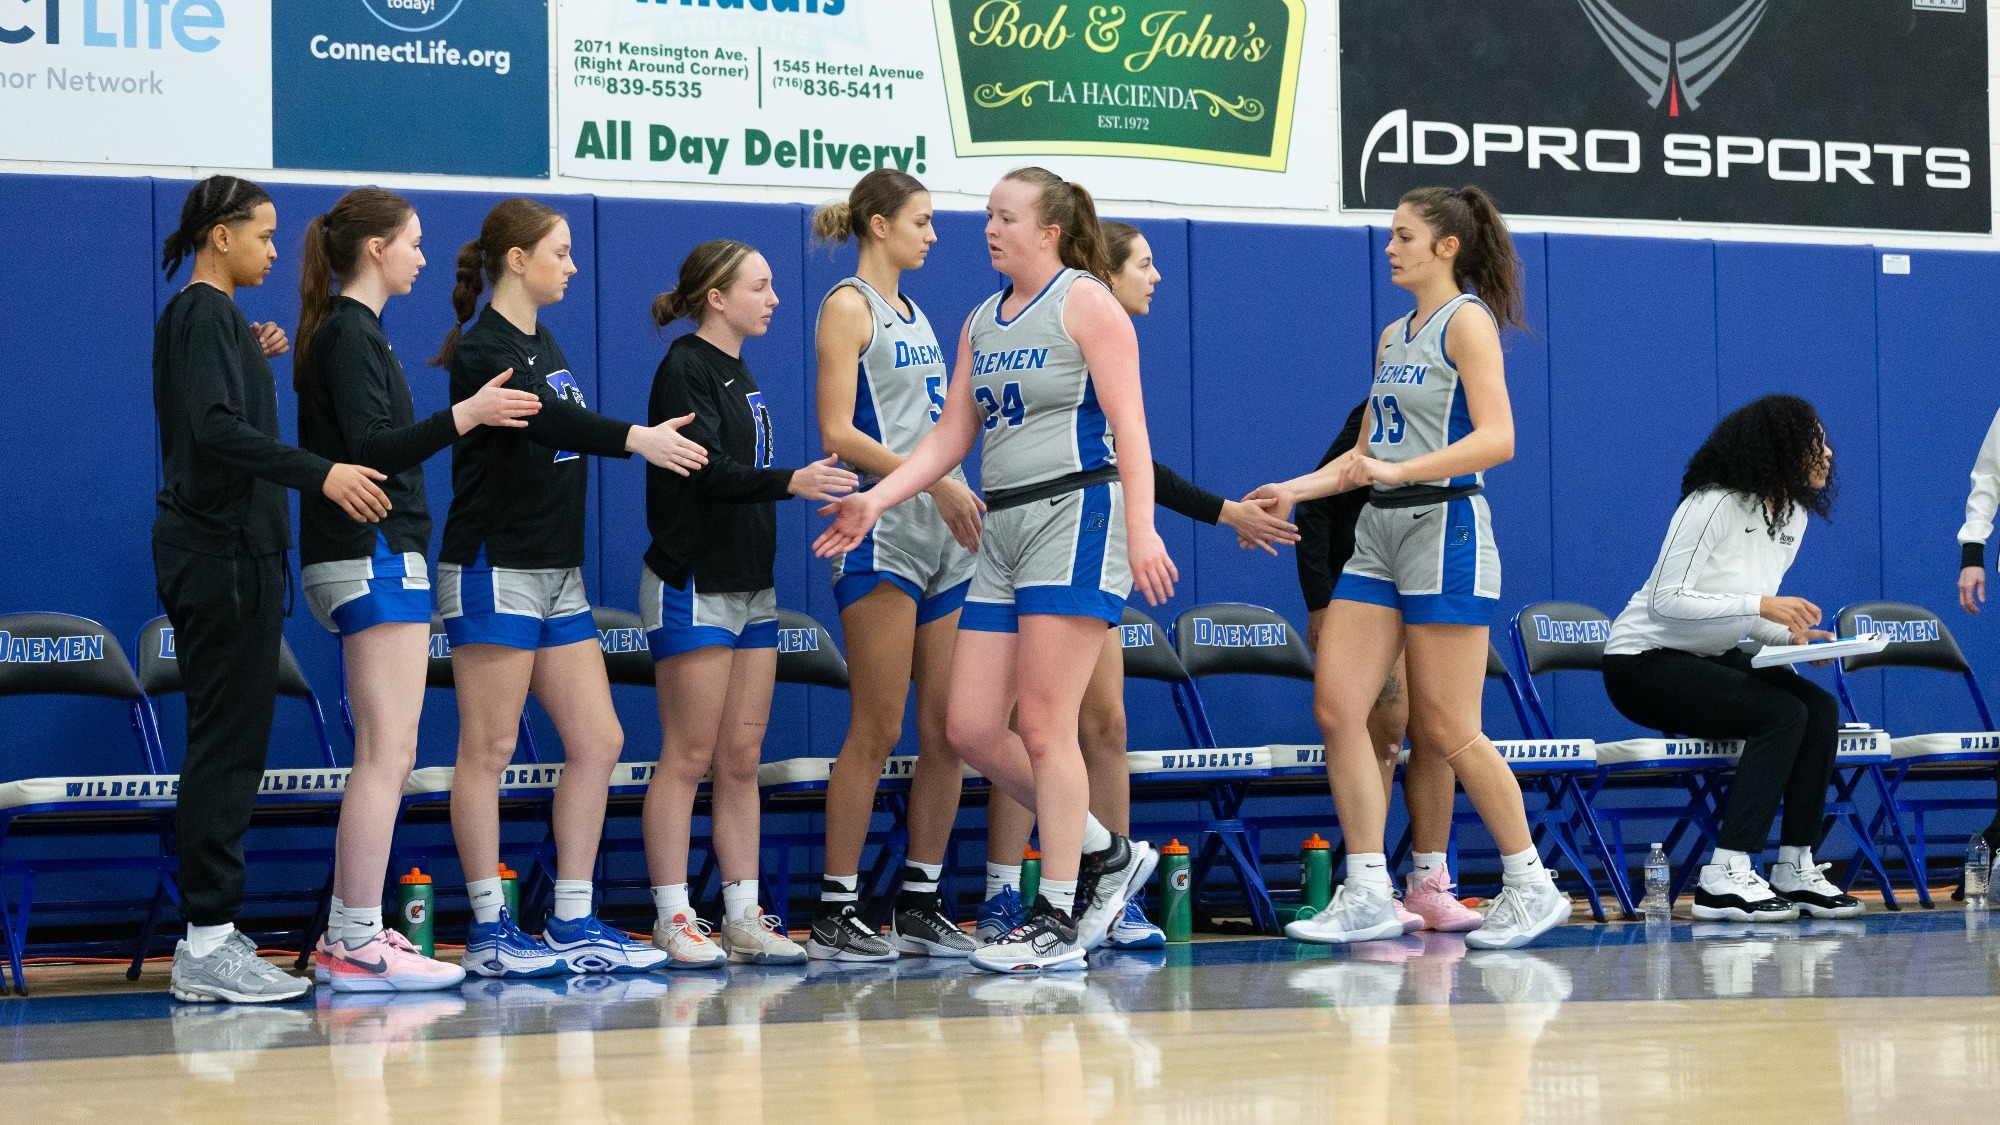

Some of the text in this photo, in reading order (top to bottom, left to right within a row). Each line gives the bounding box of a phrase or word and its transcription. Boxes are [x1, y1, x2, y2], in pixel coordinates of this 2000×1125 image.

[574, 39, 748, 61] 2071 Kensington Ave.
[968, 0, 1272, 73] Bob & John's
[310, 35, 511, 75] ConnectLife.org
[574, 57, 749, 79] (Right Around Corner)
[47, 67, 164, 95] Network
[773, 60, 925, 80] 1545 Hertel Avenue
[1047, 80, 1199, 110] LA HACIENDA
[574, 119, 926, 175] All Day Delivery!
[1360, 109, 1971, 203] ADPRO SPORTS
[894, 340, 944, 369] DAEM
[924, 374, 949, 425] 5
[974, 381, 1026, 431] 24
[1368, 393, 1406, 445] 13
[1193, 617, 1287, 647] DAEMEN
[1533, 614, 1610, 643] DAEMEN
[1495, 744, 1580, 758] WILDCATS
[1665, 741, 1738, 756] WILDCATS
[1840, 738, 1877, 752] CATS
[1960, 736, 2000, 749] WILD
[1162, 752, 1254, 769] WILDCATS
[66, 780, 180, 797] WILDCATS
[262, 773, 350, 790] ILDCAT
